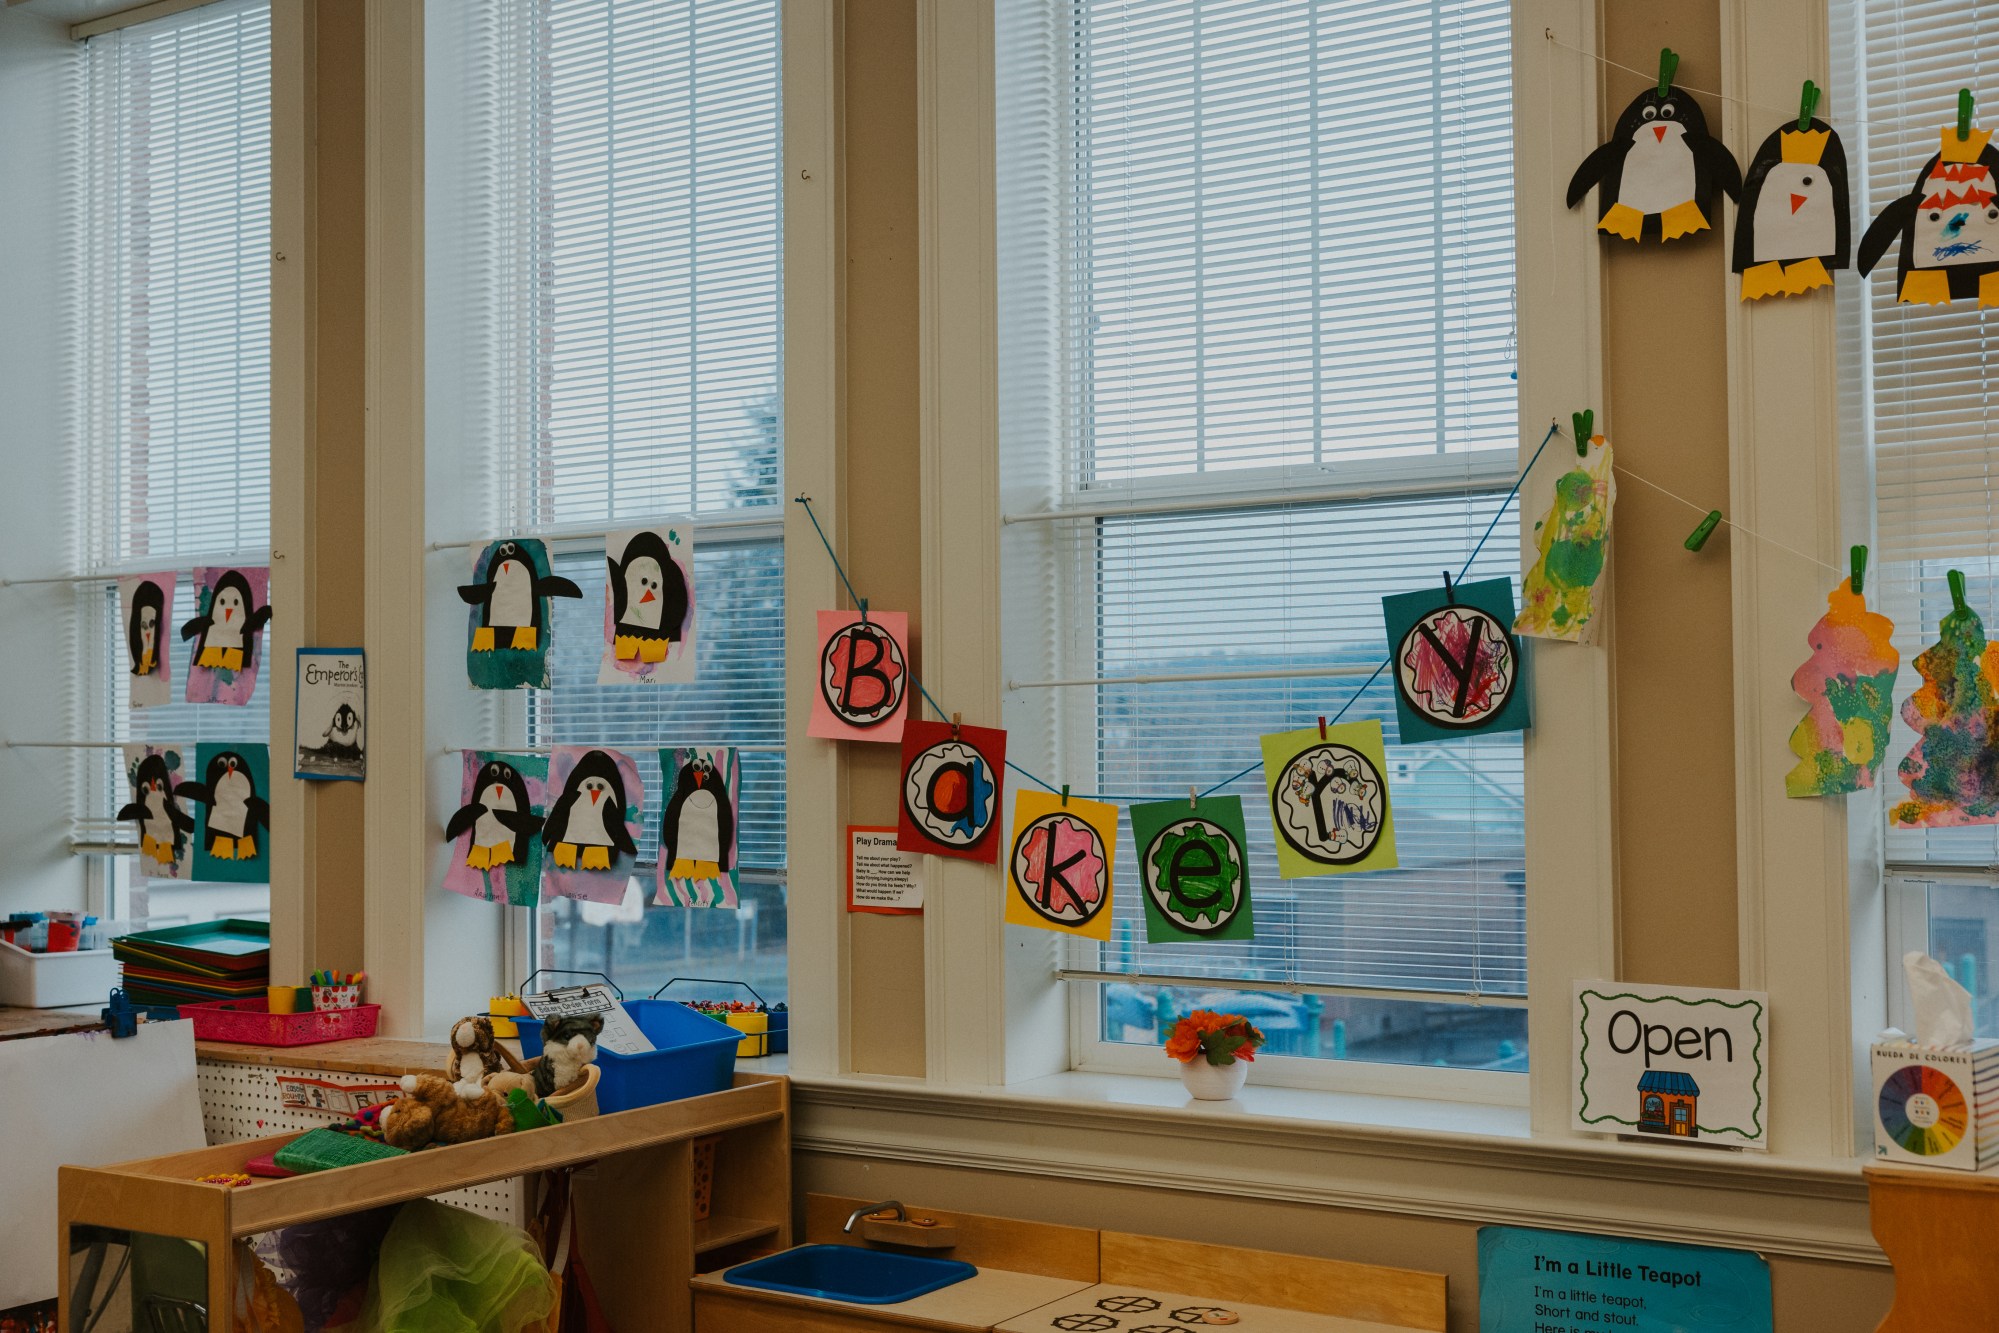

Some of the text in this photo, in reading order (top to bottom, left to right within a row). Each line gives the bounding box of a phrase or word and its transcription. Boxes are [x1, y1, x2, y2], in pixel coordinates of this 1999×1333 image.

[306, 664, 358, 685] Emperor's
[338, 660, 349, 668] The
[841, 628, 892, 715] B
[926, 761, 975, 827] a
[856, 837, 871, 847] Play
[1169, 839, 1223, 909] e
[537, 998, 602, 1014] Bakery Order Form
[1608, 1010, 1733, 1068] Open
[1877, 1050, 1904, 1058] RUEDA
[1534, 1255, 1702, 1288] I'm a Little Teapot
[1534, 1286, 1647, 1310] I'm a little teapot,
[1535, 1304, 1639, 1326] Short and stout.
